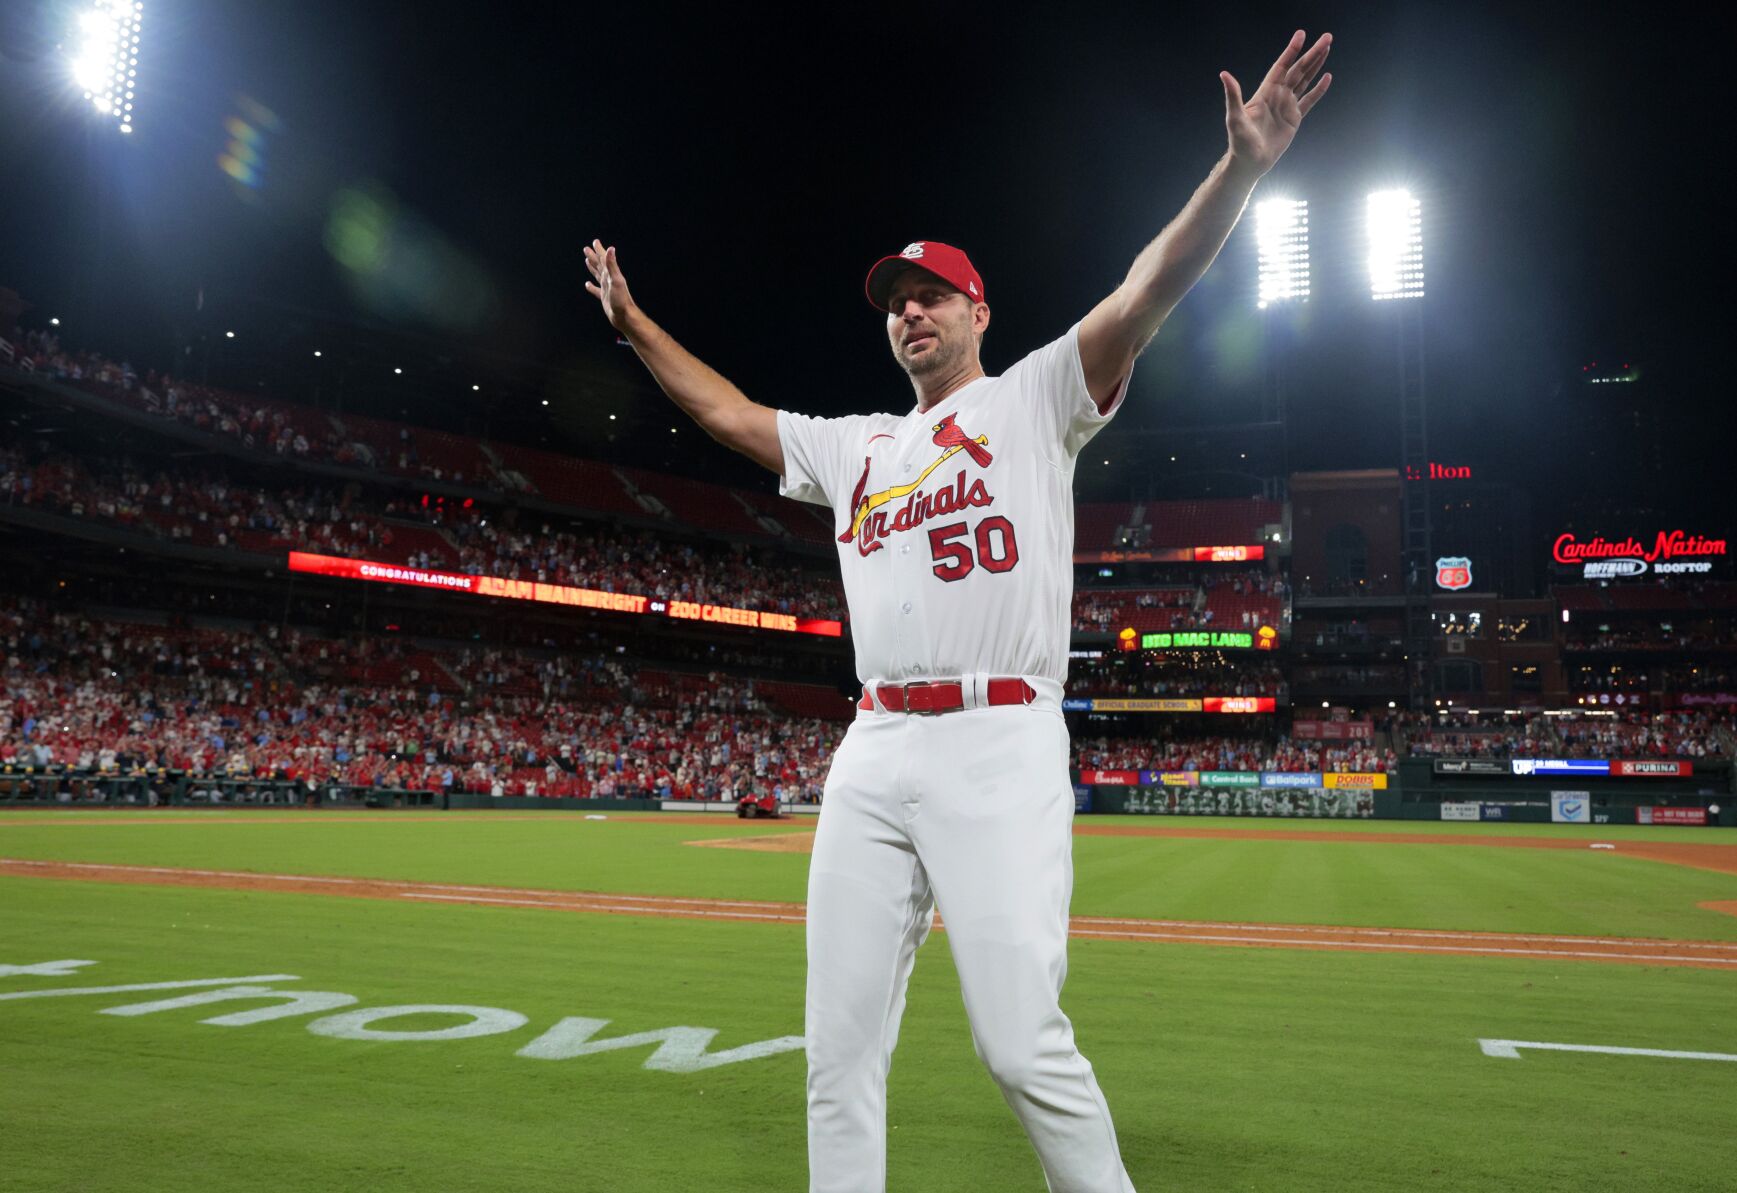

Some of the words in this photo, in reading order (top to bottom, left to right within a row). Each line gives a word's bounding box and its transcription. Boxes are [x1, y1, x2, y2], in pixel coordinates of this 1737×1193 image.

[1406, 462, 1471, 479] lton
[853, 469, 995, 558] Cardinals
[928, 515, 1019, 582] 50
[1553, 533, 1644, 563] Cardinals
[1644, 530, 1727, 562] Nation
[1654, 562, 1712, 574] ROOFTOP
[1441, 569, 1466, 585] 66
[360, 564, 471, 588] CONGRATULATIONS
[478, 576, 533, 600] ADAM
[535, 583, 647, 613] WAINWRIGHT
[651, 601, 665, 612] ON
[669, 600, 700, 620] 200
[702, 605, 759, 628] CAREER
[760, 612, 797, 632] WINS
[1142, 634, 1172, 649] BIG
[1173, 632, 1209, 648] MAC
[1211, 632, 1252, 648] LAND
[1635, 764, 1677, 772] PURINA
[1276, 774, 1317, 786] Ballpark
[1336, 775, 1374, 785] DOBBS
